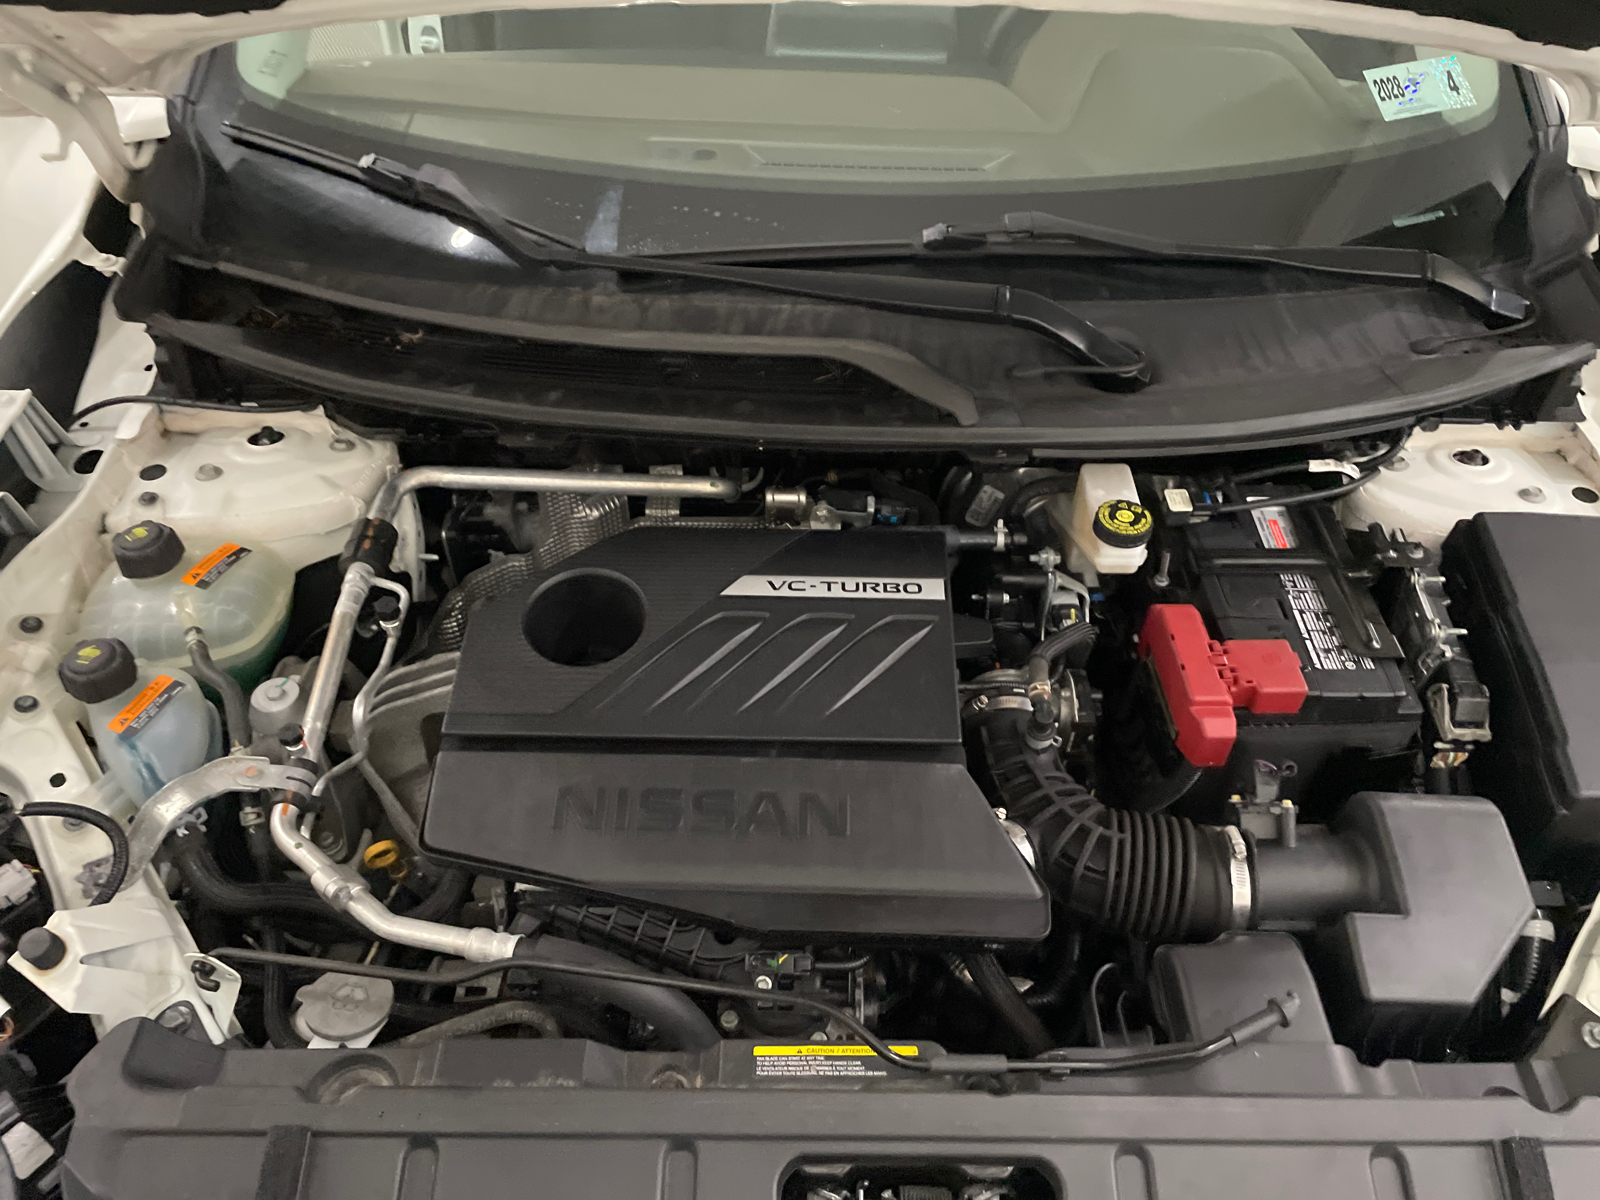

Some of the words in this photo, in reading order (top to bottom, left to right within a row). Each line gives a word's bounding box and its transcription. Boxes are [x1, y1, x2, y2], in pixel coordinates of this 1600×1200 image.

[1373, 75, 1405, 101] 2028
[1446, 70, 1460, 95] 4
[766, 580, 922, 594] VC-TURBO
[551, 786, 850, 837] NISSAN
